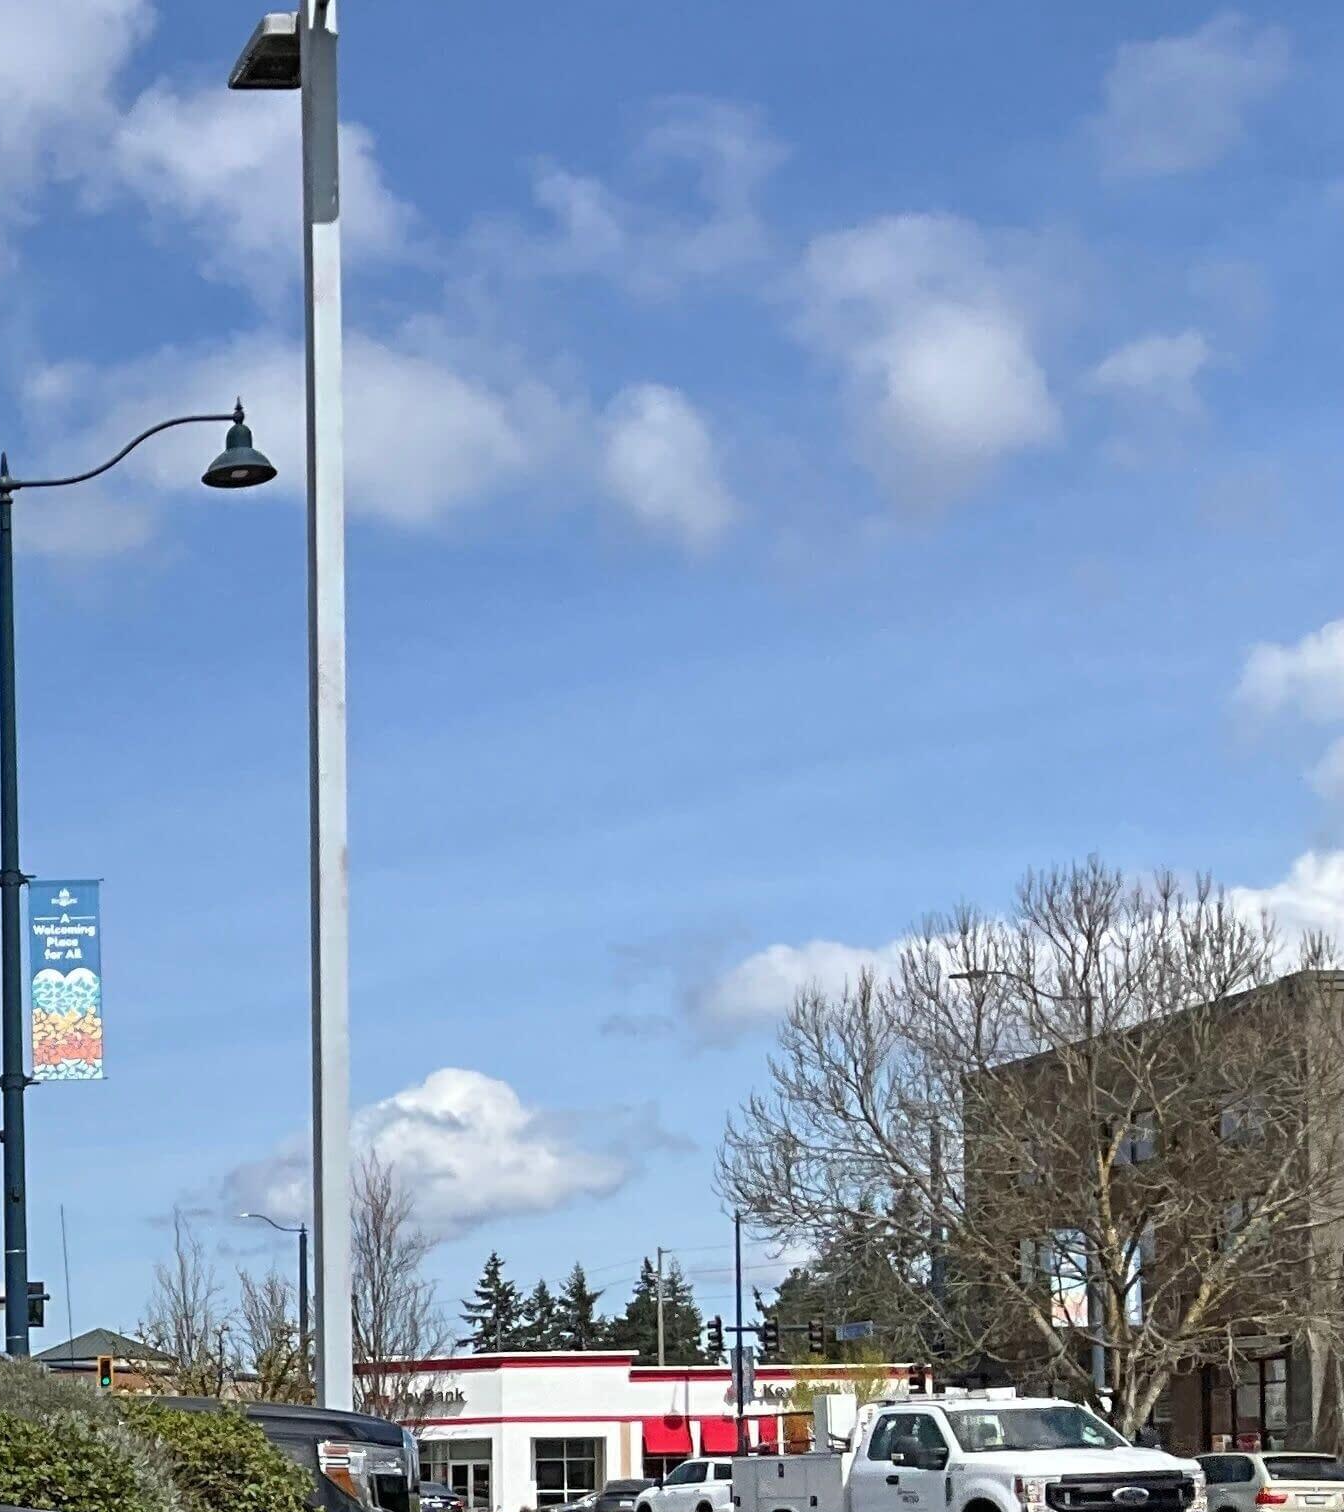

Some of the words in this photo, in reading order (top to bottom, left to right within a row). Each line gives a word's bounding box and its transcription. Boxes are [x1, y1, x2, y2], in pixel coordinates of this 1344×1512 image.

[60, 913, 70, 924] A
[32, 923, 96, 937] Welcoming
[46, 936, 79, 948] Place
[44, 948, 63, 960] for
